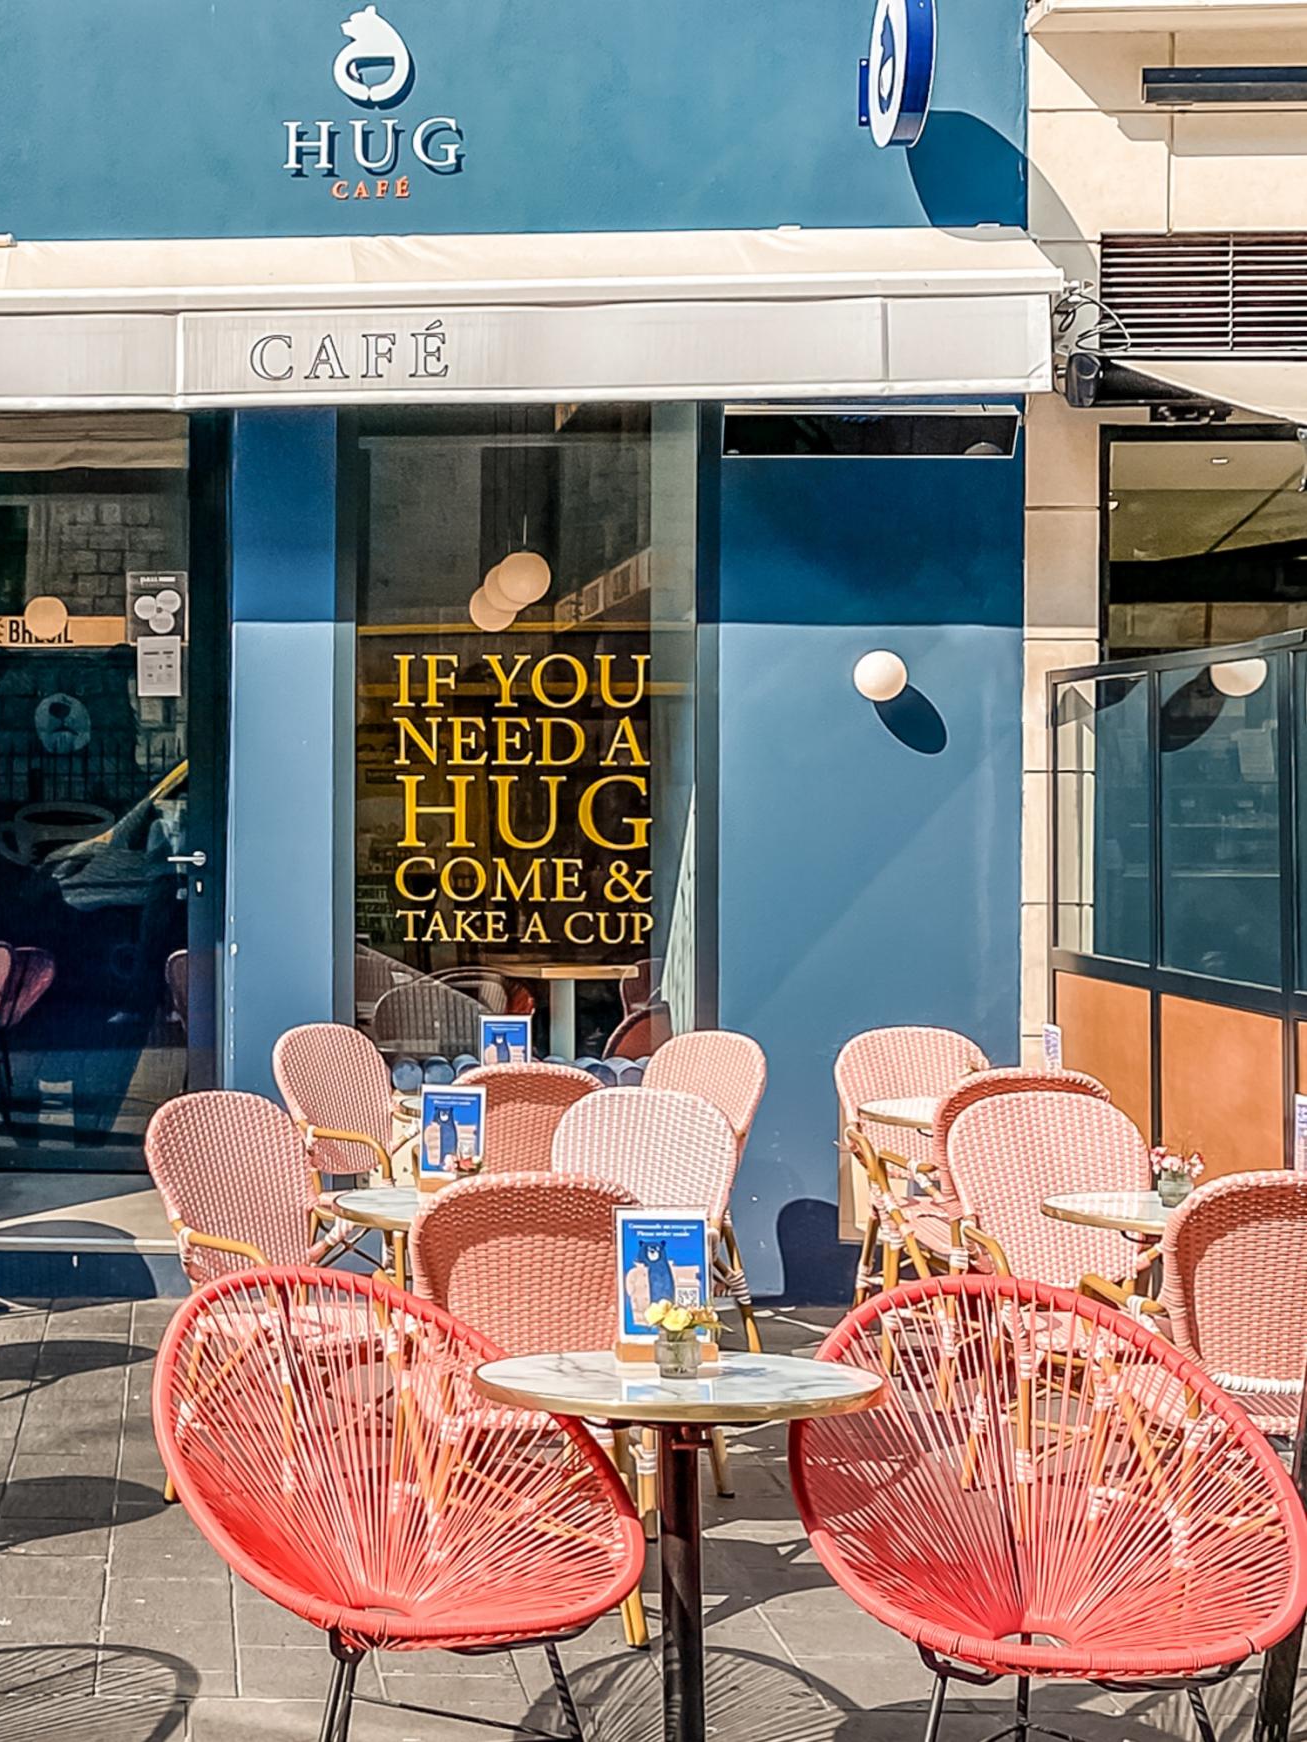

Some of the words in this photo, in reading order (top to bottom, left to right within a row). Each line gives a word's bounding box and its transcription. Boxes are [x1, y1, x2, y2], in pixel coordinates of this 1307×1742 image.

[282, 117, 461, 169] HUG
[331, 176, 411, 200] CAFÉ
[250, 319, 449, 381] CAFÉ
[393, 654, 459, 708] IF
[482, 653, 651, 708] YOU
[393, 716, 586, 766] NEED
[599, 715, 651, 766] A
[396, 774, 653, 851] HUG
[395, 856, 587, 902] COME
[603, 860, 653, 903] &
[396, 909, 509, 942] TAKE
[520, 911, 551, 943] A
[563, 911, 654, 945] CUP
